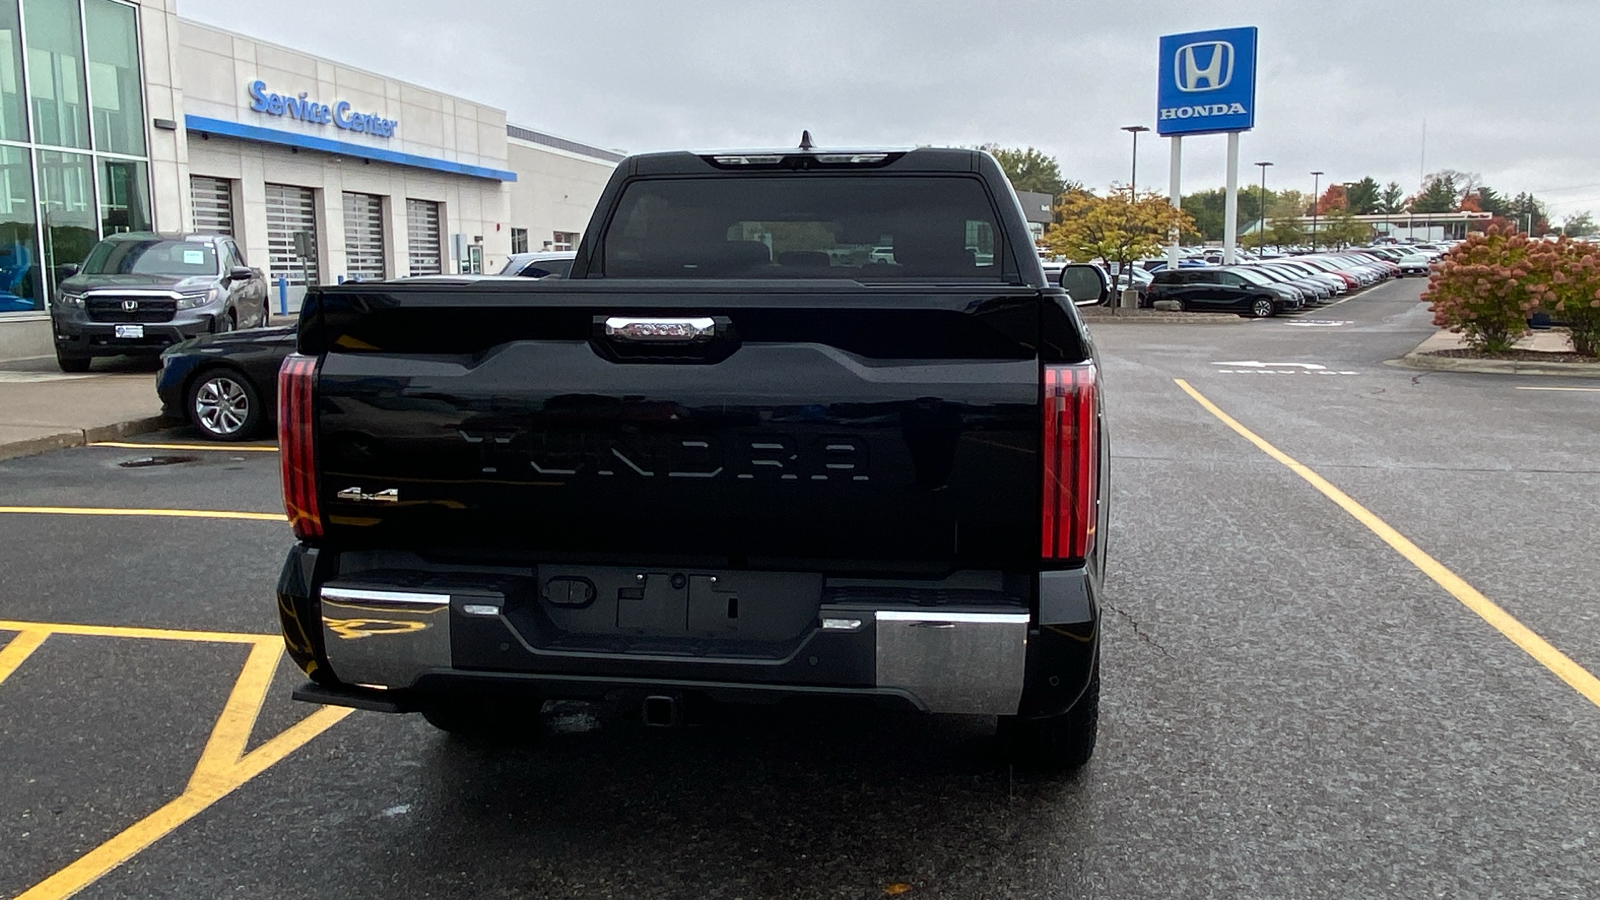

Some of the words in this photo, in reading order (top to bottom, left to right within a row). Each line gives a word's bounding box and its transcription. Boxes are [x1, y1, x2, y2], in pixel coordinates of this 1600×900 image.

[248, 80, 332, 125] Service
[332, 100, 398, 138] Center
[1160, 102, 1247, 120] HONDA
[634, 323, 690, 336] TOYOTA
[459, 430, 869, 480] TUNDRA
[337, 486, 399, 502] 4x4
